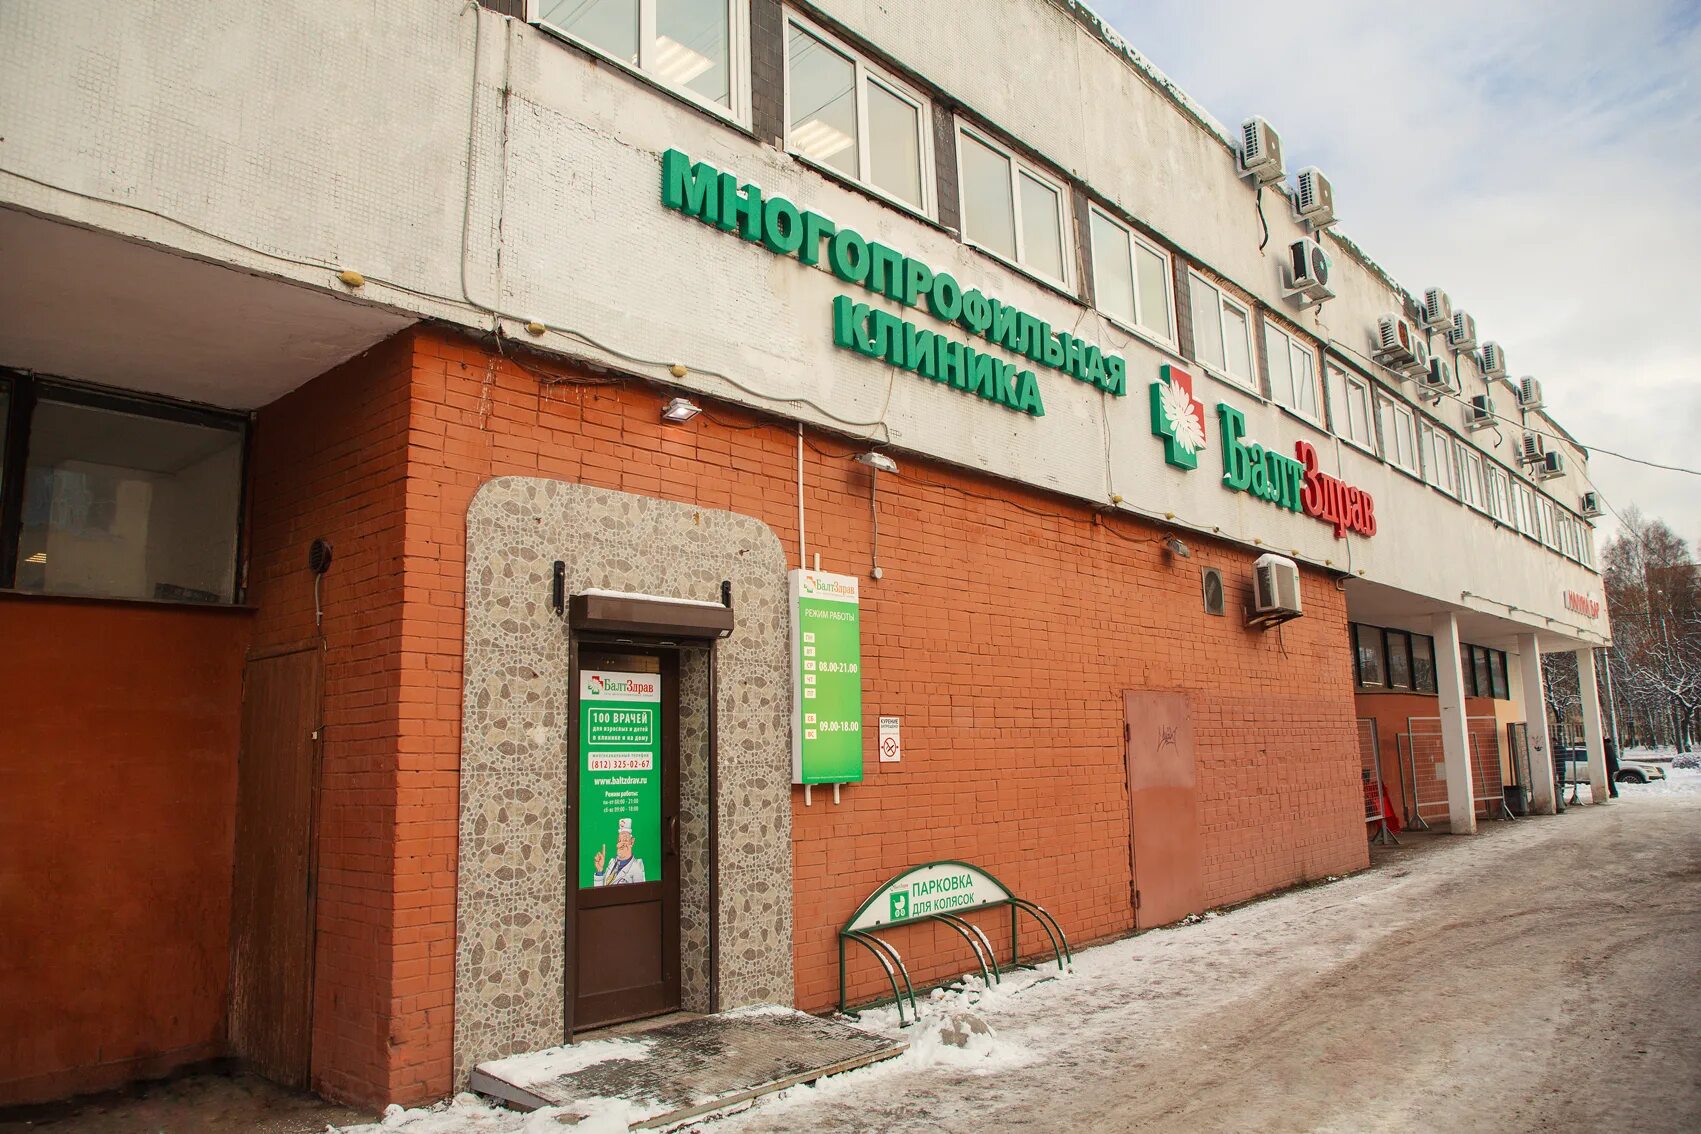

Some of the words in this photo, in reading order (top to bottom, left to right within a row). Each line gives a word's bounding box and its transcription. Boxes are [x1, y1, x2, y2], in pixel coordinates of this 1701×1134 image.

[662, 147, 1127, 397] МНОГОПРОФИЛЬНАЯ
[833, 295, 1046, 417] КЛИНИКА
[1217, 402, 1377, 539] БалтЗдрав
[816, 579, 855, 595] БалтЗдрав
[805, 608, 829, 619] РЕЖИМ
[829, 611, 855, 622] РАБОТЫ
[818, 661, 858, 673] 08.00-21.00
[604, 678, 654, 695] БалтЗдрав
[593, 712, 610, 723] 100
[613, 711, 648, 724] ВРАЧЕЙ
[819, 721, 859, 732] 09.00-18.00
[591, 760, 611, 770] (812)
[613, 760, 650, 769] 325-02-67
[594, 776, 648, 786] www.baltzdrav.ru
[912, 873, 973, 898] ПАРКОВКА
[912, 900, 932, 917] ДЛЯ
[934, 893, 975, 911] КОЛЯСОК
